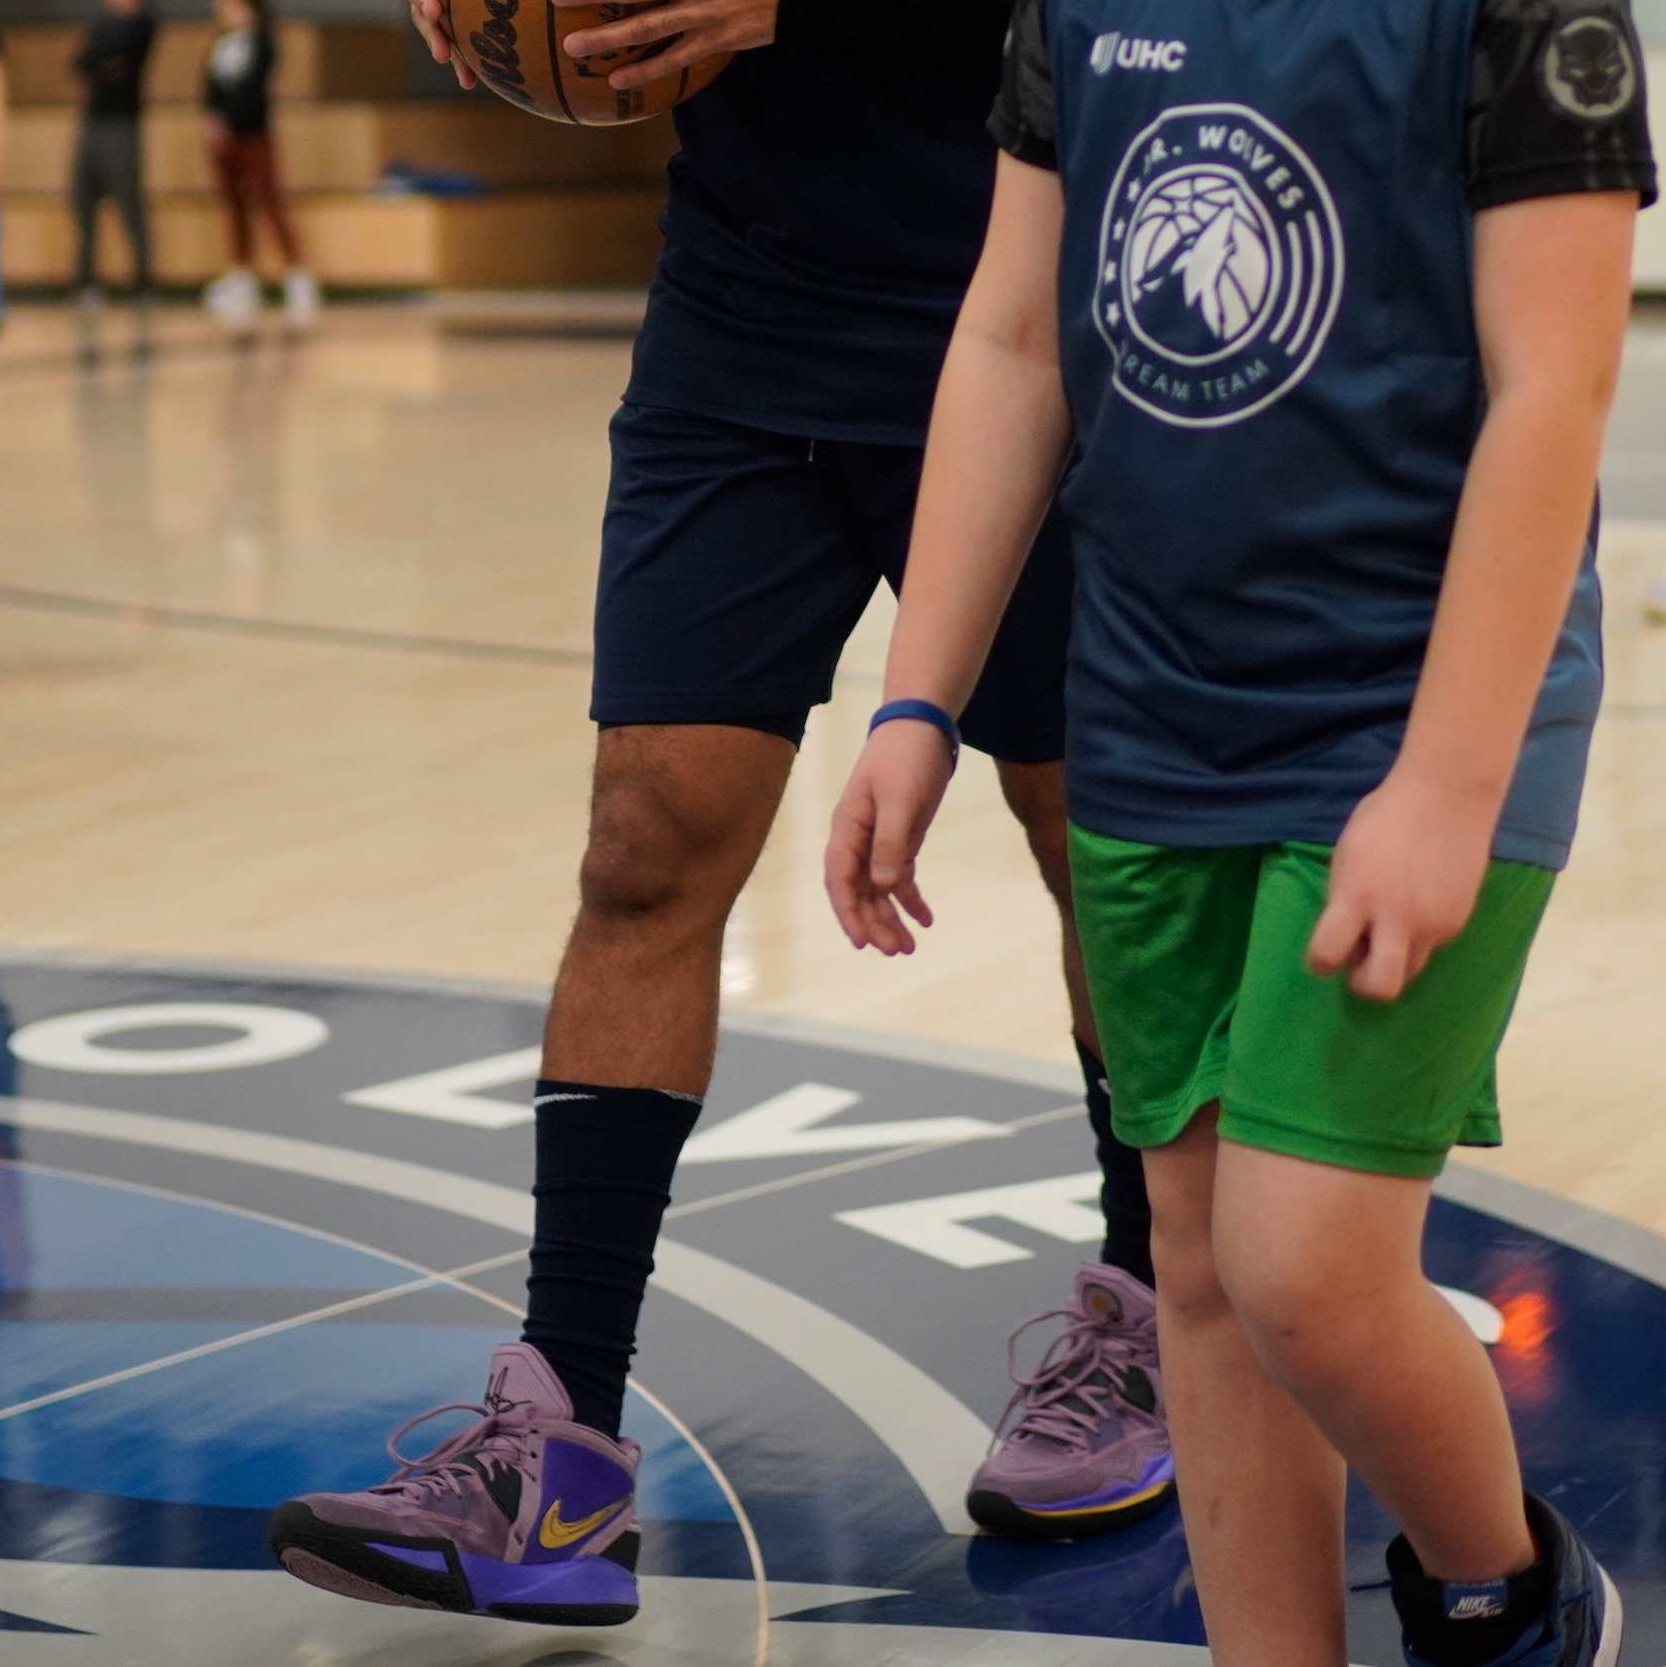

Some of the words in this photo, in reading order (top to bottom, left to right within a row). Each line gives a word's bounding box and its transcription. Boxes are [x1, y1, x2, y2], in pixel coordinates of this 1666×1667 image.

[1116, 37, 1188, 72] UHC
[1198, 125, 1305, 210] WOLVES
[1199, 357, 1271, 402] TEAM
